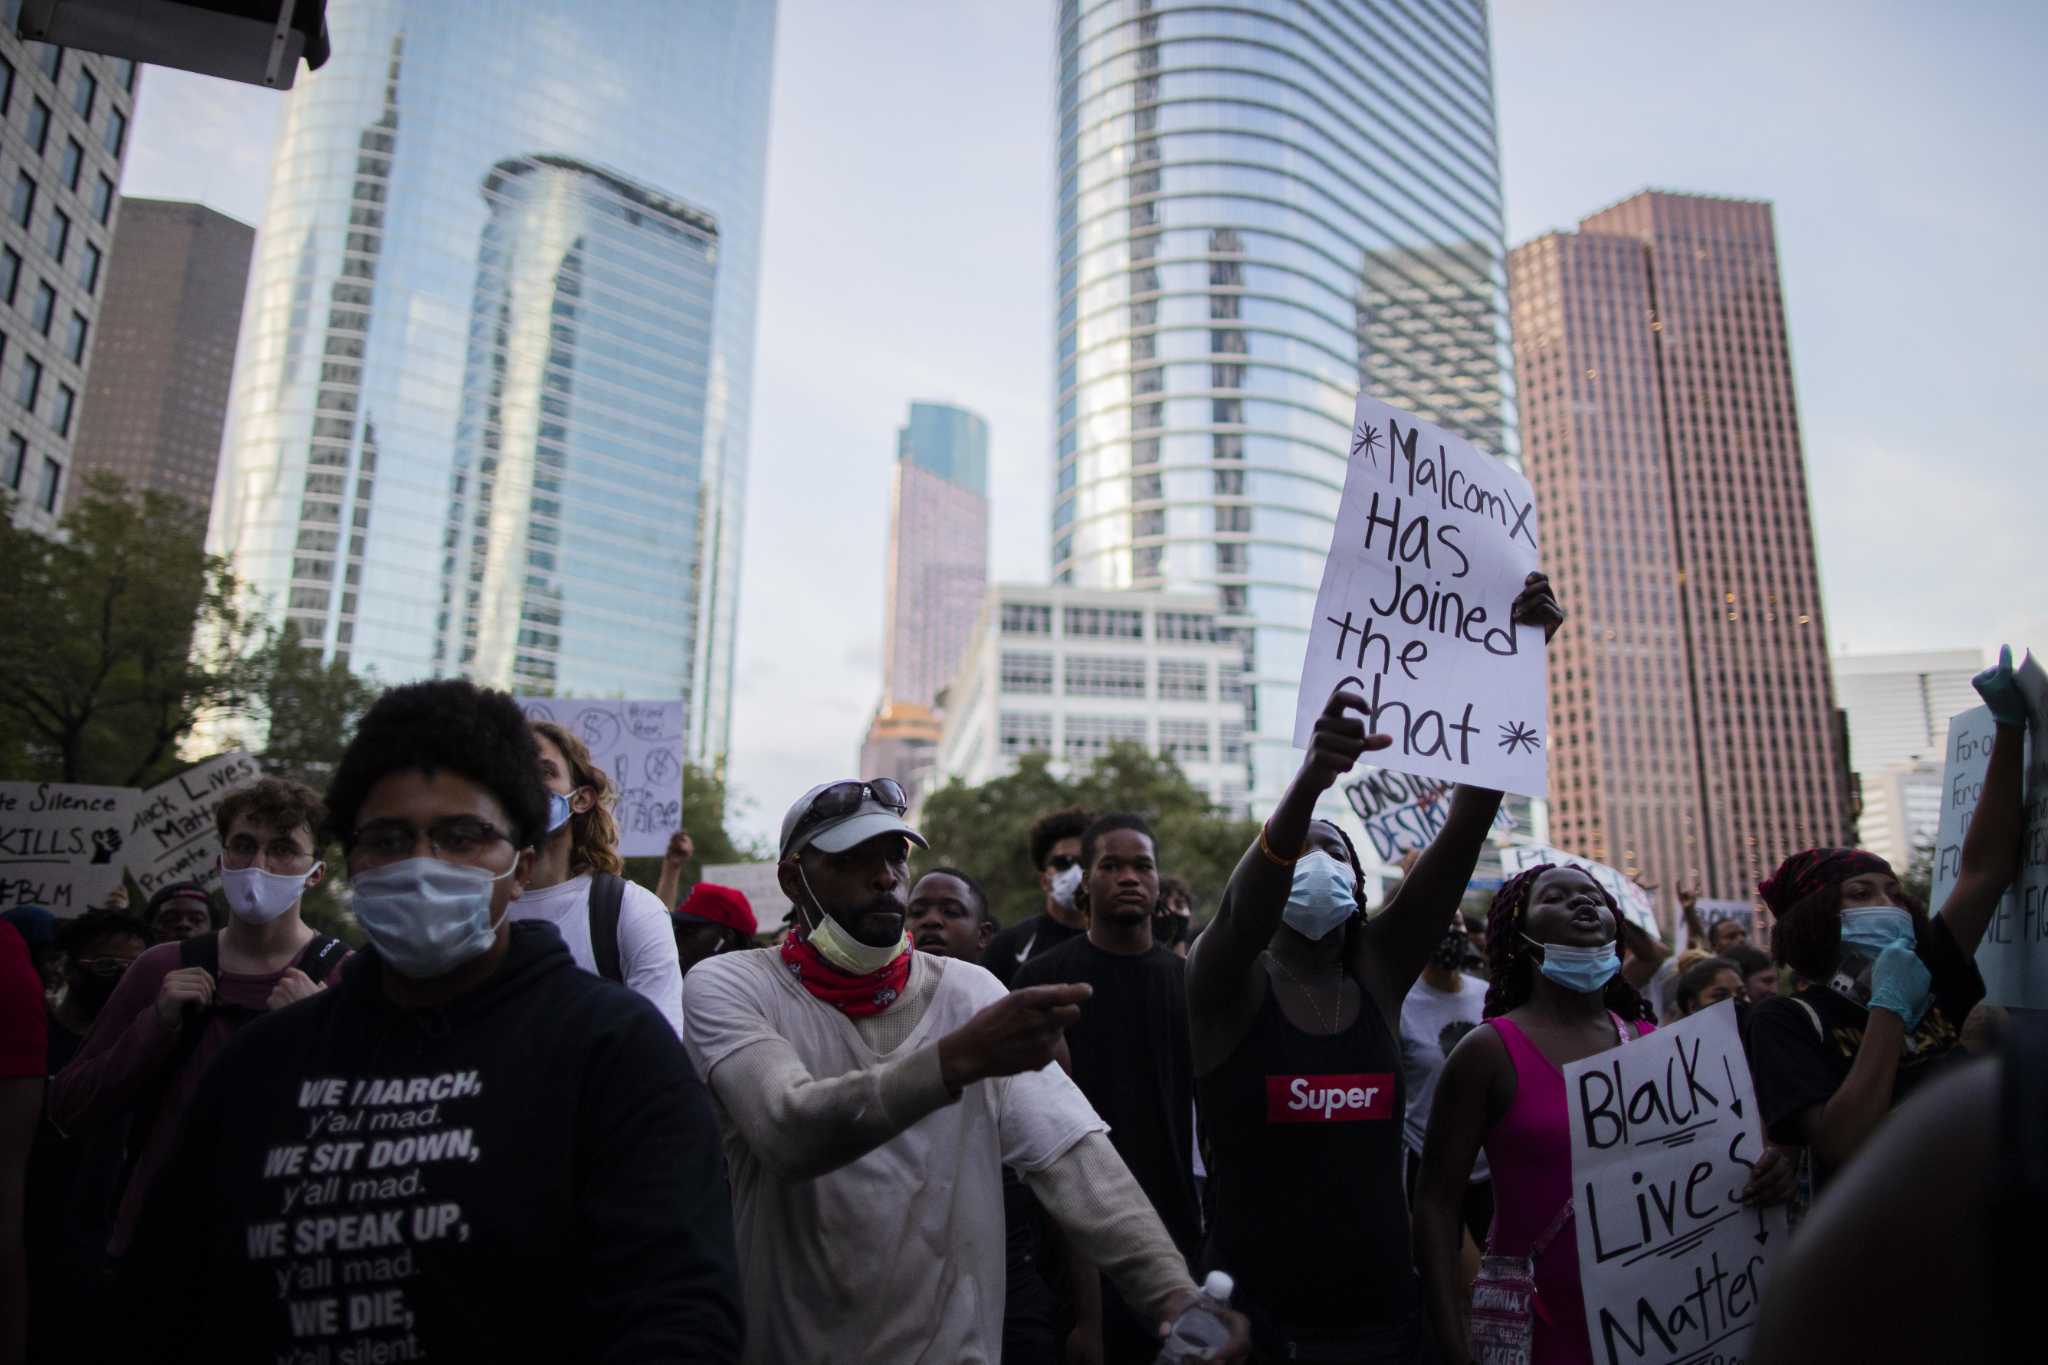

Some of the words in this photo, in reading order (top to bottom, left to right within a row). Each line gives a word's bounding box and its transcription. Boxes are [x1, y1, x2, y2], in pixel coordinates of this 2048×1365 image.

[1369, 565, 1519, 656] Joined
[1326, 611, 1429, 681] the
[29, 783, 117, 813] Silence
[178, 757, 255, 801] Lives
[297, 1078, 349, 1109] WE
[1287, 1078, 1380, 1119] Super
[1579, 1035, 1720, 1150] Black
[305, 1109, 367, 1140] y'al
[368, 1104, 443, 1132] mad.
[263, 1145, 309, 1180] WE
[309, 1140, 366, 1174] SIT
[367, 1126, 481, 1170] DOWN,
[280, 1174, 342, 1215] y'all
[347, 1167, 428, 1202] mad.
[246, 1221, 289, 1261] WE
[292, 1207, 406, 1255] SPEAK
[412, 1201, 471, 1243] UP,
[274, 1255, 335, 1300] y'all
[342, 1247, 425, 1285] mad.
[289, 1298, 342, 1338] WE
[348, 1288, 417, 1333] DIE,
[1599, 1251, 1765, 1365] Matter
